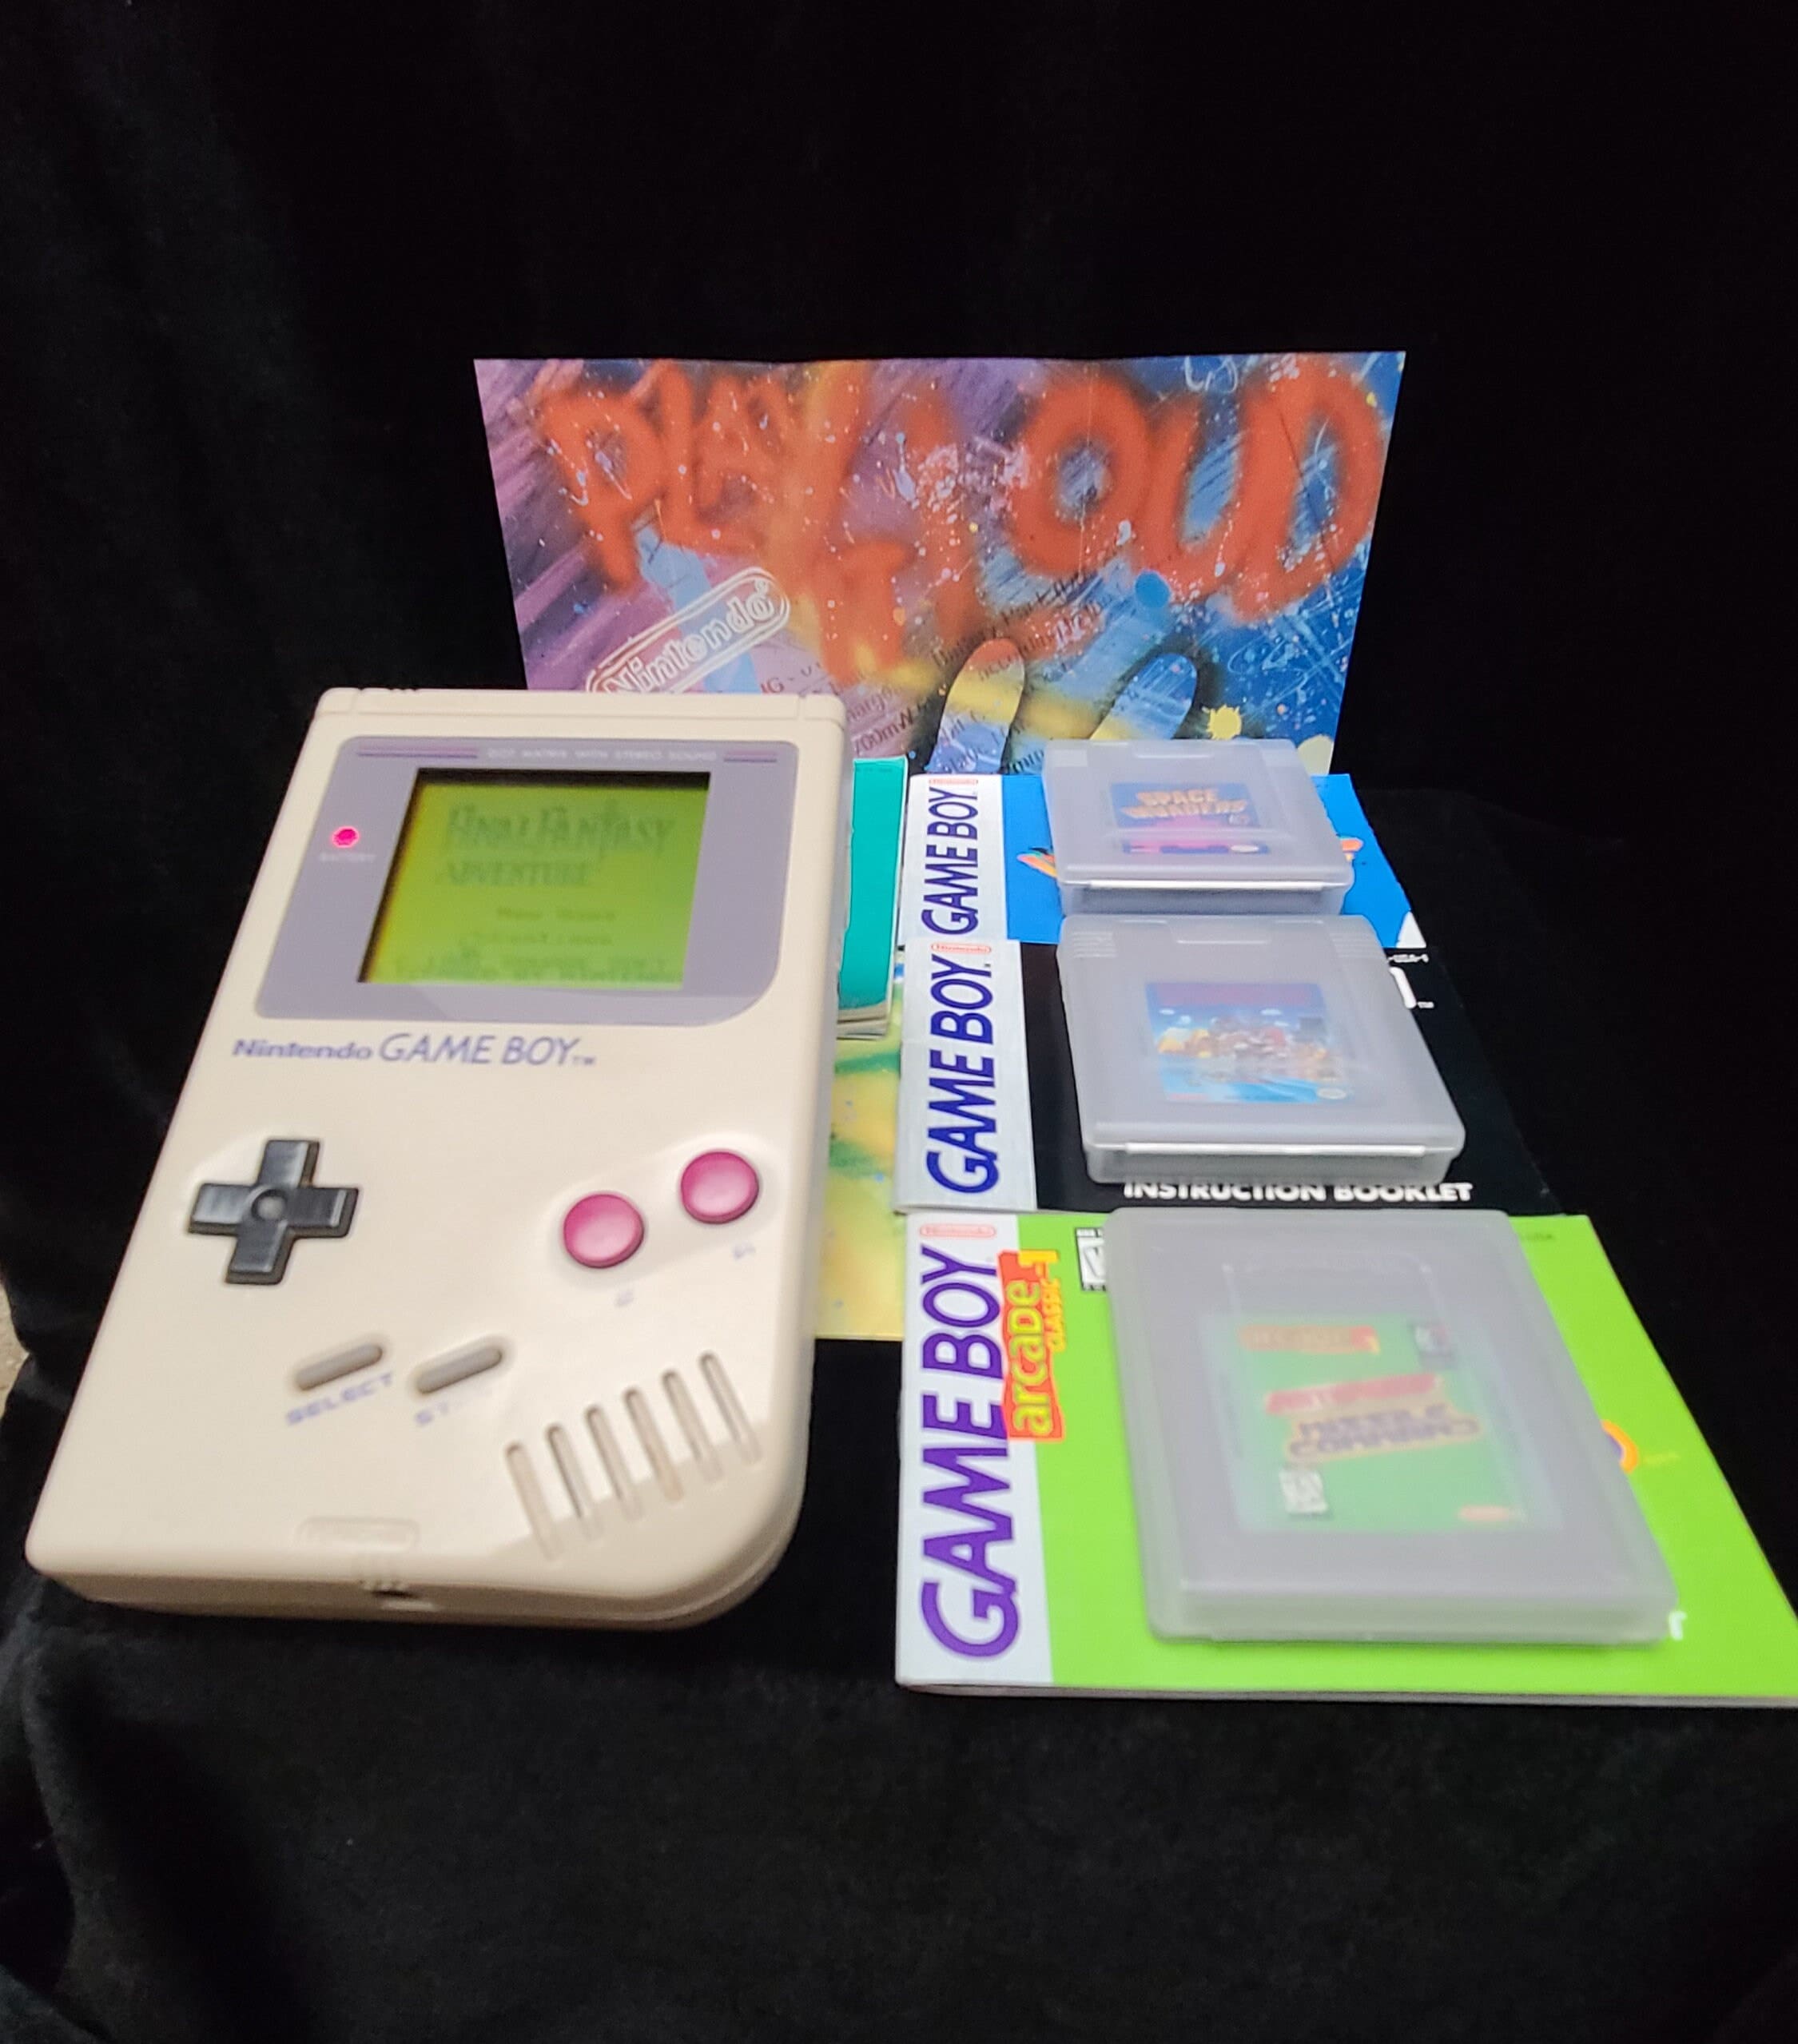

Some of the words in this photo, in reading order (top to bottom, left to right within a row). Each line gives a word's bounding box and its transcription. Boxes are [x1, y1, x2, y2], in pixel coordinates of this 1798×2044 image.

[601, 593, 775, 694] Nintendo
[927, 787, 978, 840] BOY
[921, 845, 978, 935] GAME
[930, 953, 994, 1044] BOY
[232, 1039, 372, 1060] Nintendo
[378, 1032, 495, 1065] GAME
[500, 1036, 581, 1066] BOY
[926, 1049, 1000, 1193] GAME
[1123, 1182, 1326, 1201] INSTRUCTION
[1333, 1183, 1474, 1203] BOOKLET
[921, 1243, 1004, 1380] BOY
[921, 1394, 1019, 1657] GAME
